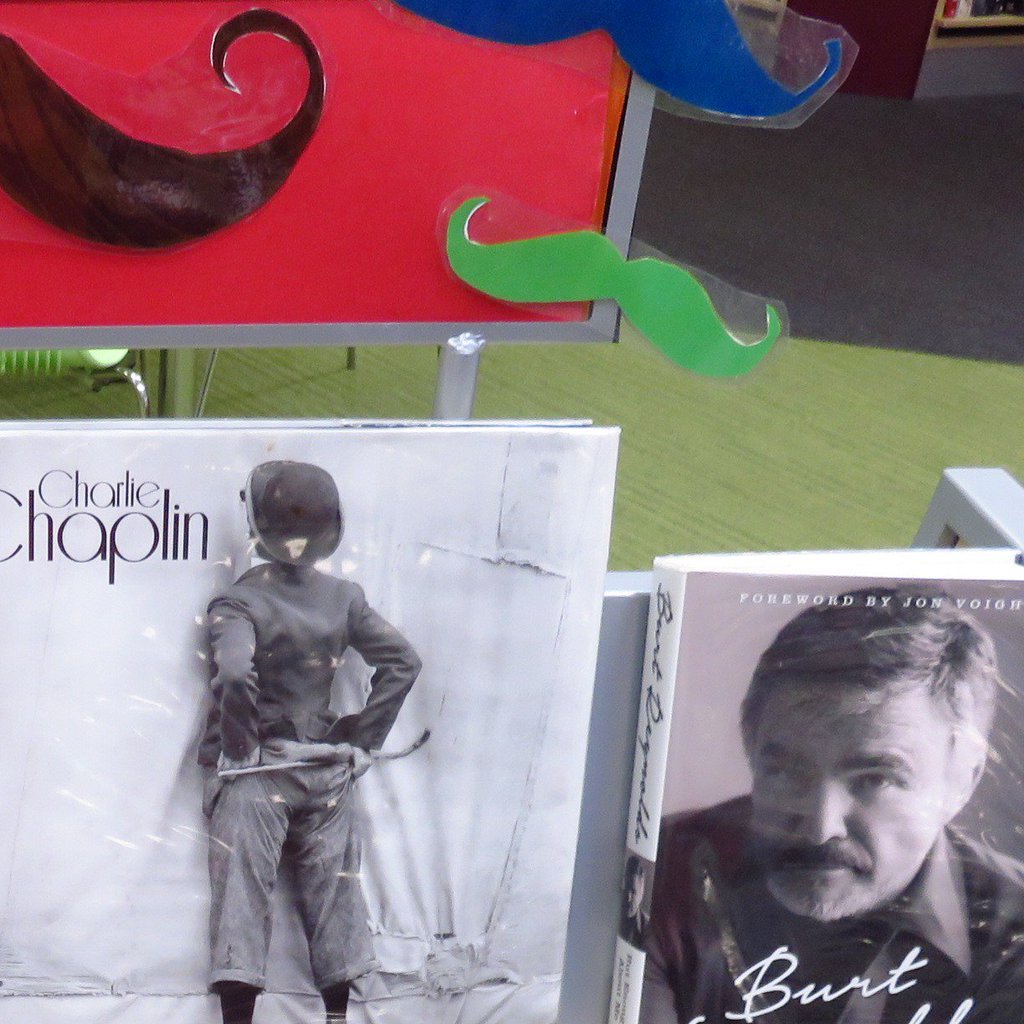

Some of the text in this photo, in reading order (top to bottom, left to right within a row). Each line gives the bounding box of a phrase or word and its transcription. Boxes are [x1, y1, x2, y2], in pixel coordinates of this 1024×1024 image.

[38, 469, 160, 509] Charlie
[739, 593, 854, 607] FOREWORD
[866, 596, 892, 608] BY
[902, 597, 944, 609] JON
[725, 945, 928, 1023] Burt
